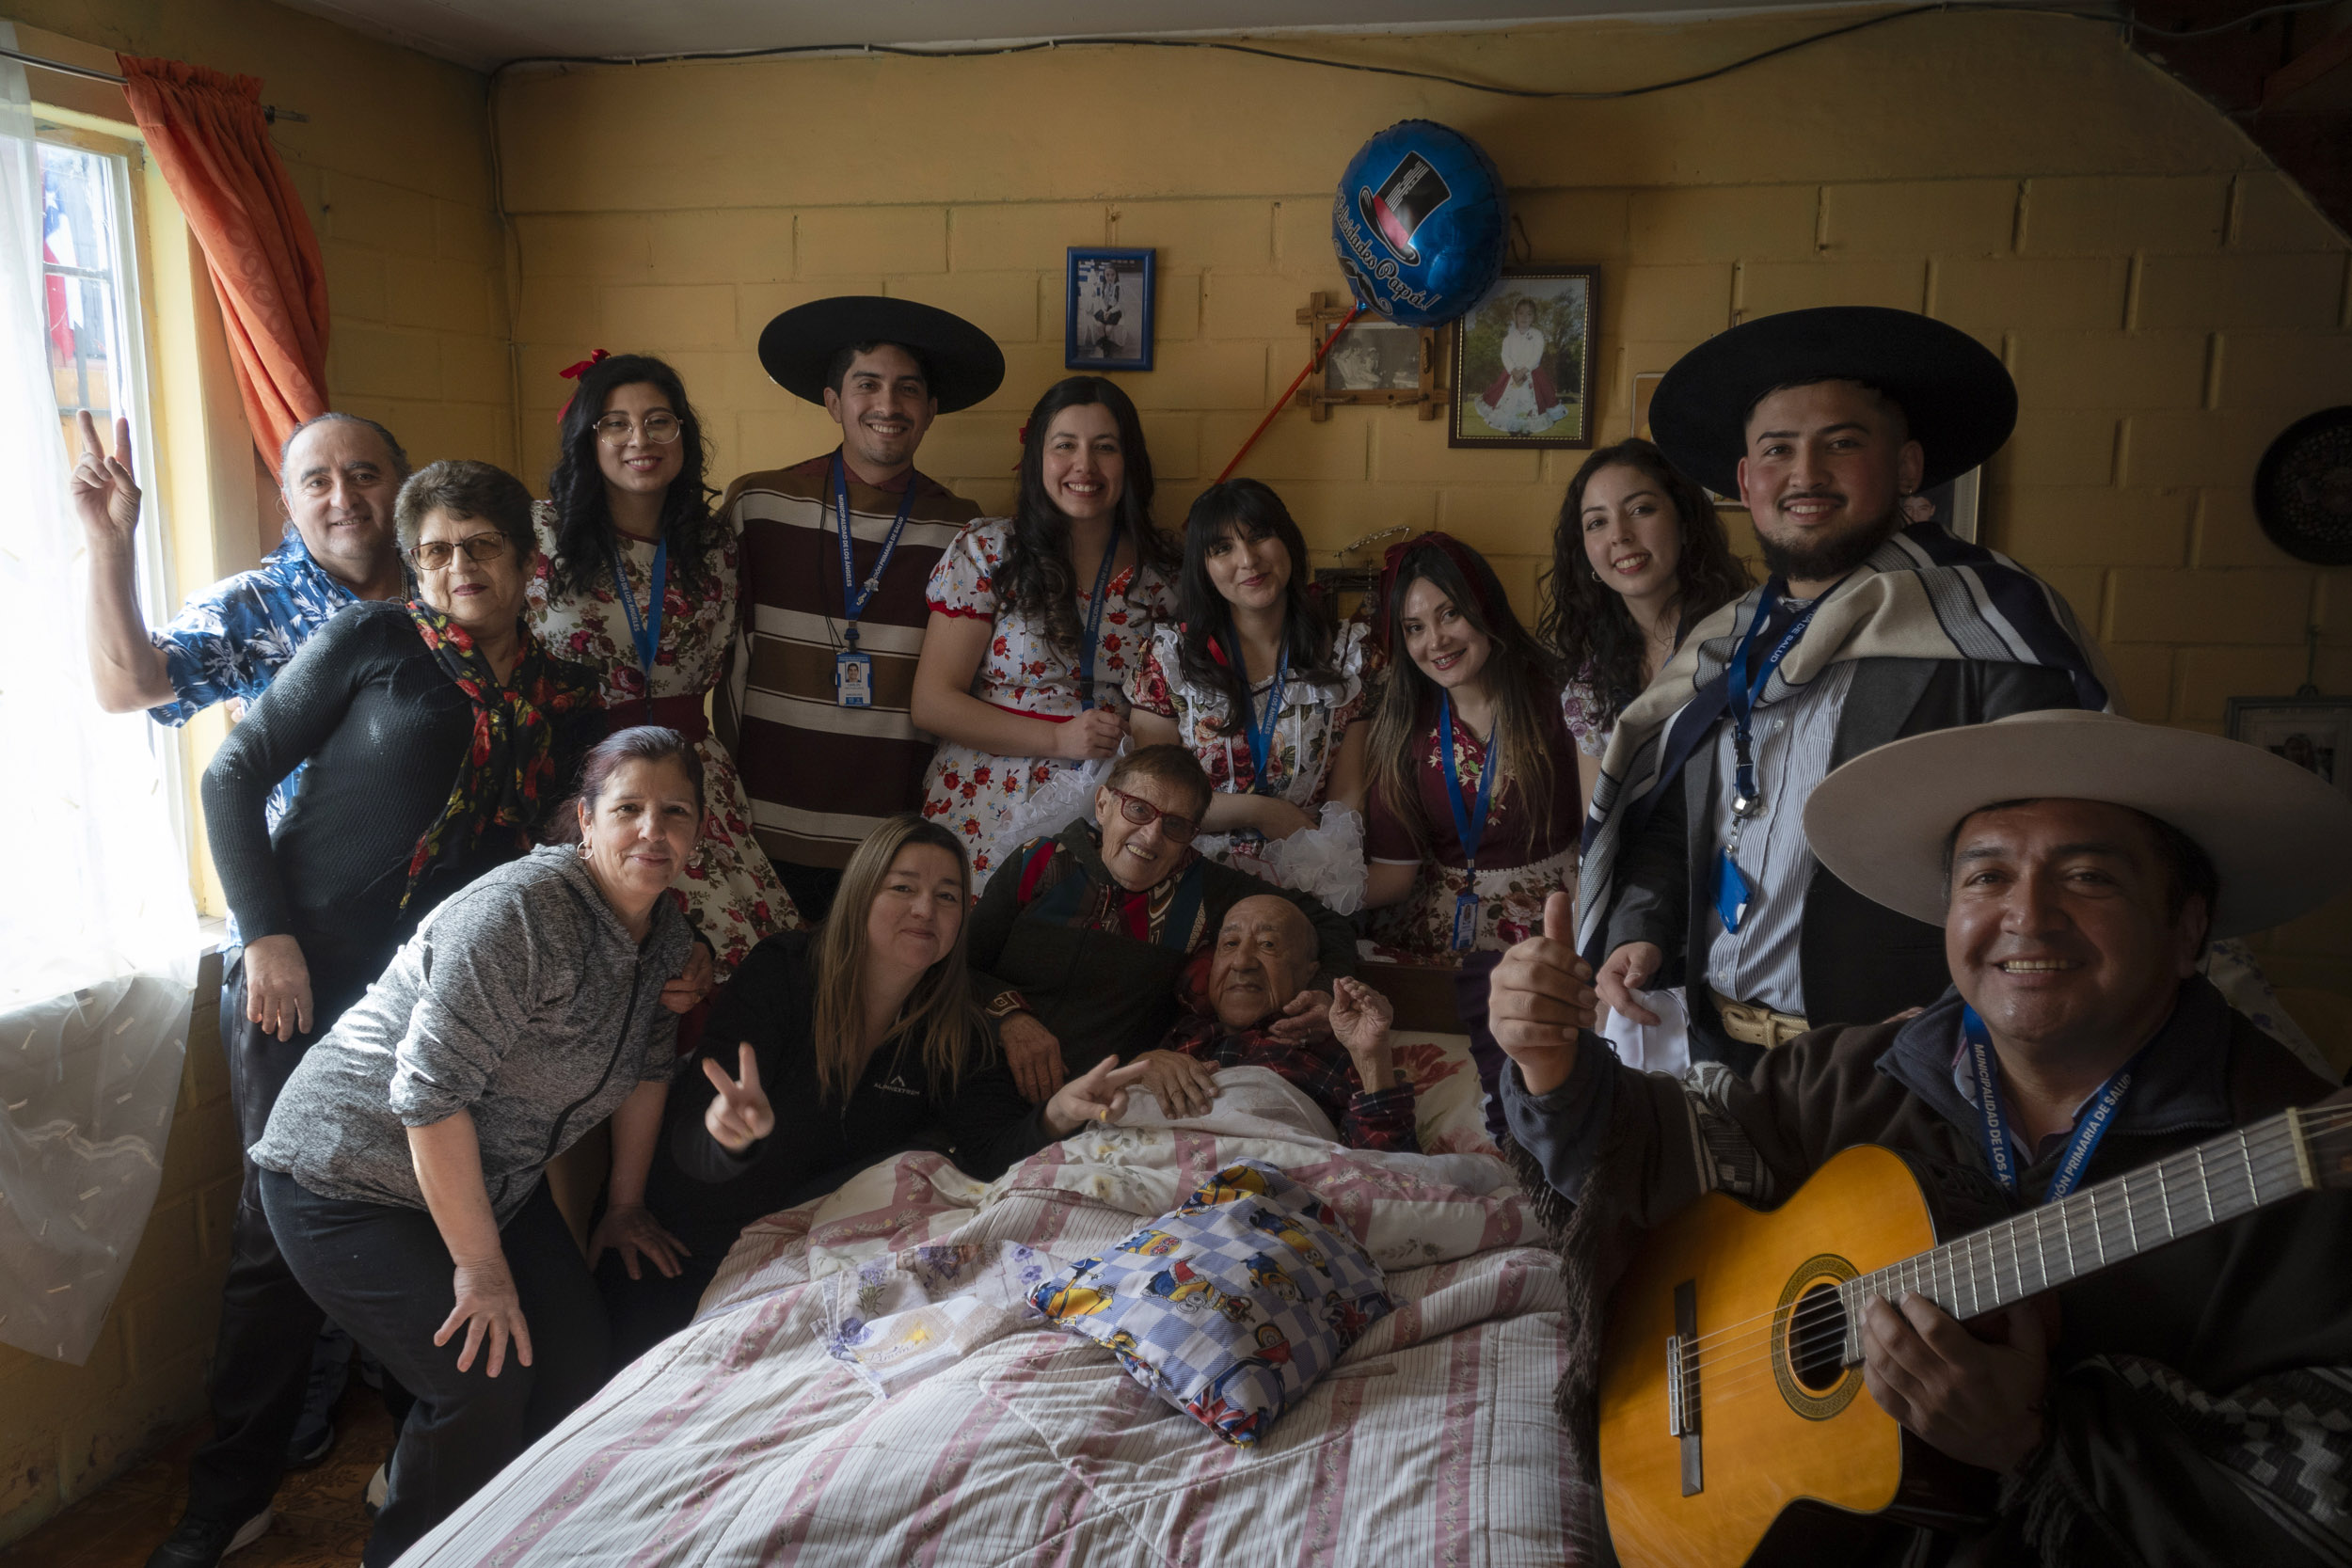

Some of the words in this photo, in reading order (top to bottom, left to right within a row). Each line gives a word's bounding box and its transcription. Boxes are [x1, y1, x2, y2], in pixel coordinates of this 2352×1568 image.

[1375, 258, 1442, 311] Papá!
[838, 494, 849, 540] MUNICIPALIDAD
[873, 566, 882, 579] CIÓN
[880, 541, 894, 566] PRIMARIA
[890, 532, 897, 542] DE
[894, 516, 903, 533] SALUD
[621, 582, 629, 592] DE
[624, 592, 632, 603] LOS
[1791, 623, 1805, 635] DE
[1770, 634, 1794, 663] SALUD
[1974, 1043, 1999, 1128] MUNICIPALIDAD
[1989, 1129, 2003, 1146] DE
[2052, 1174, 2072, 1204] CIÓN
[2064, 1120, 2101, 1177] PRIMARIA
[2093, 1103, 2111, 1122] DE
[2104, 1074, 2132, 1106] SALUD
[1993, 1147, 2008, 1171] LOS
